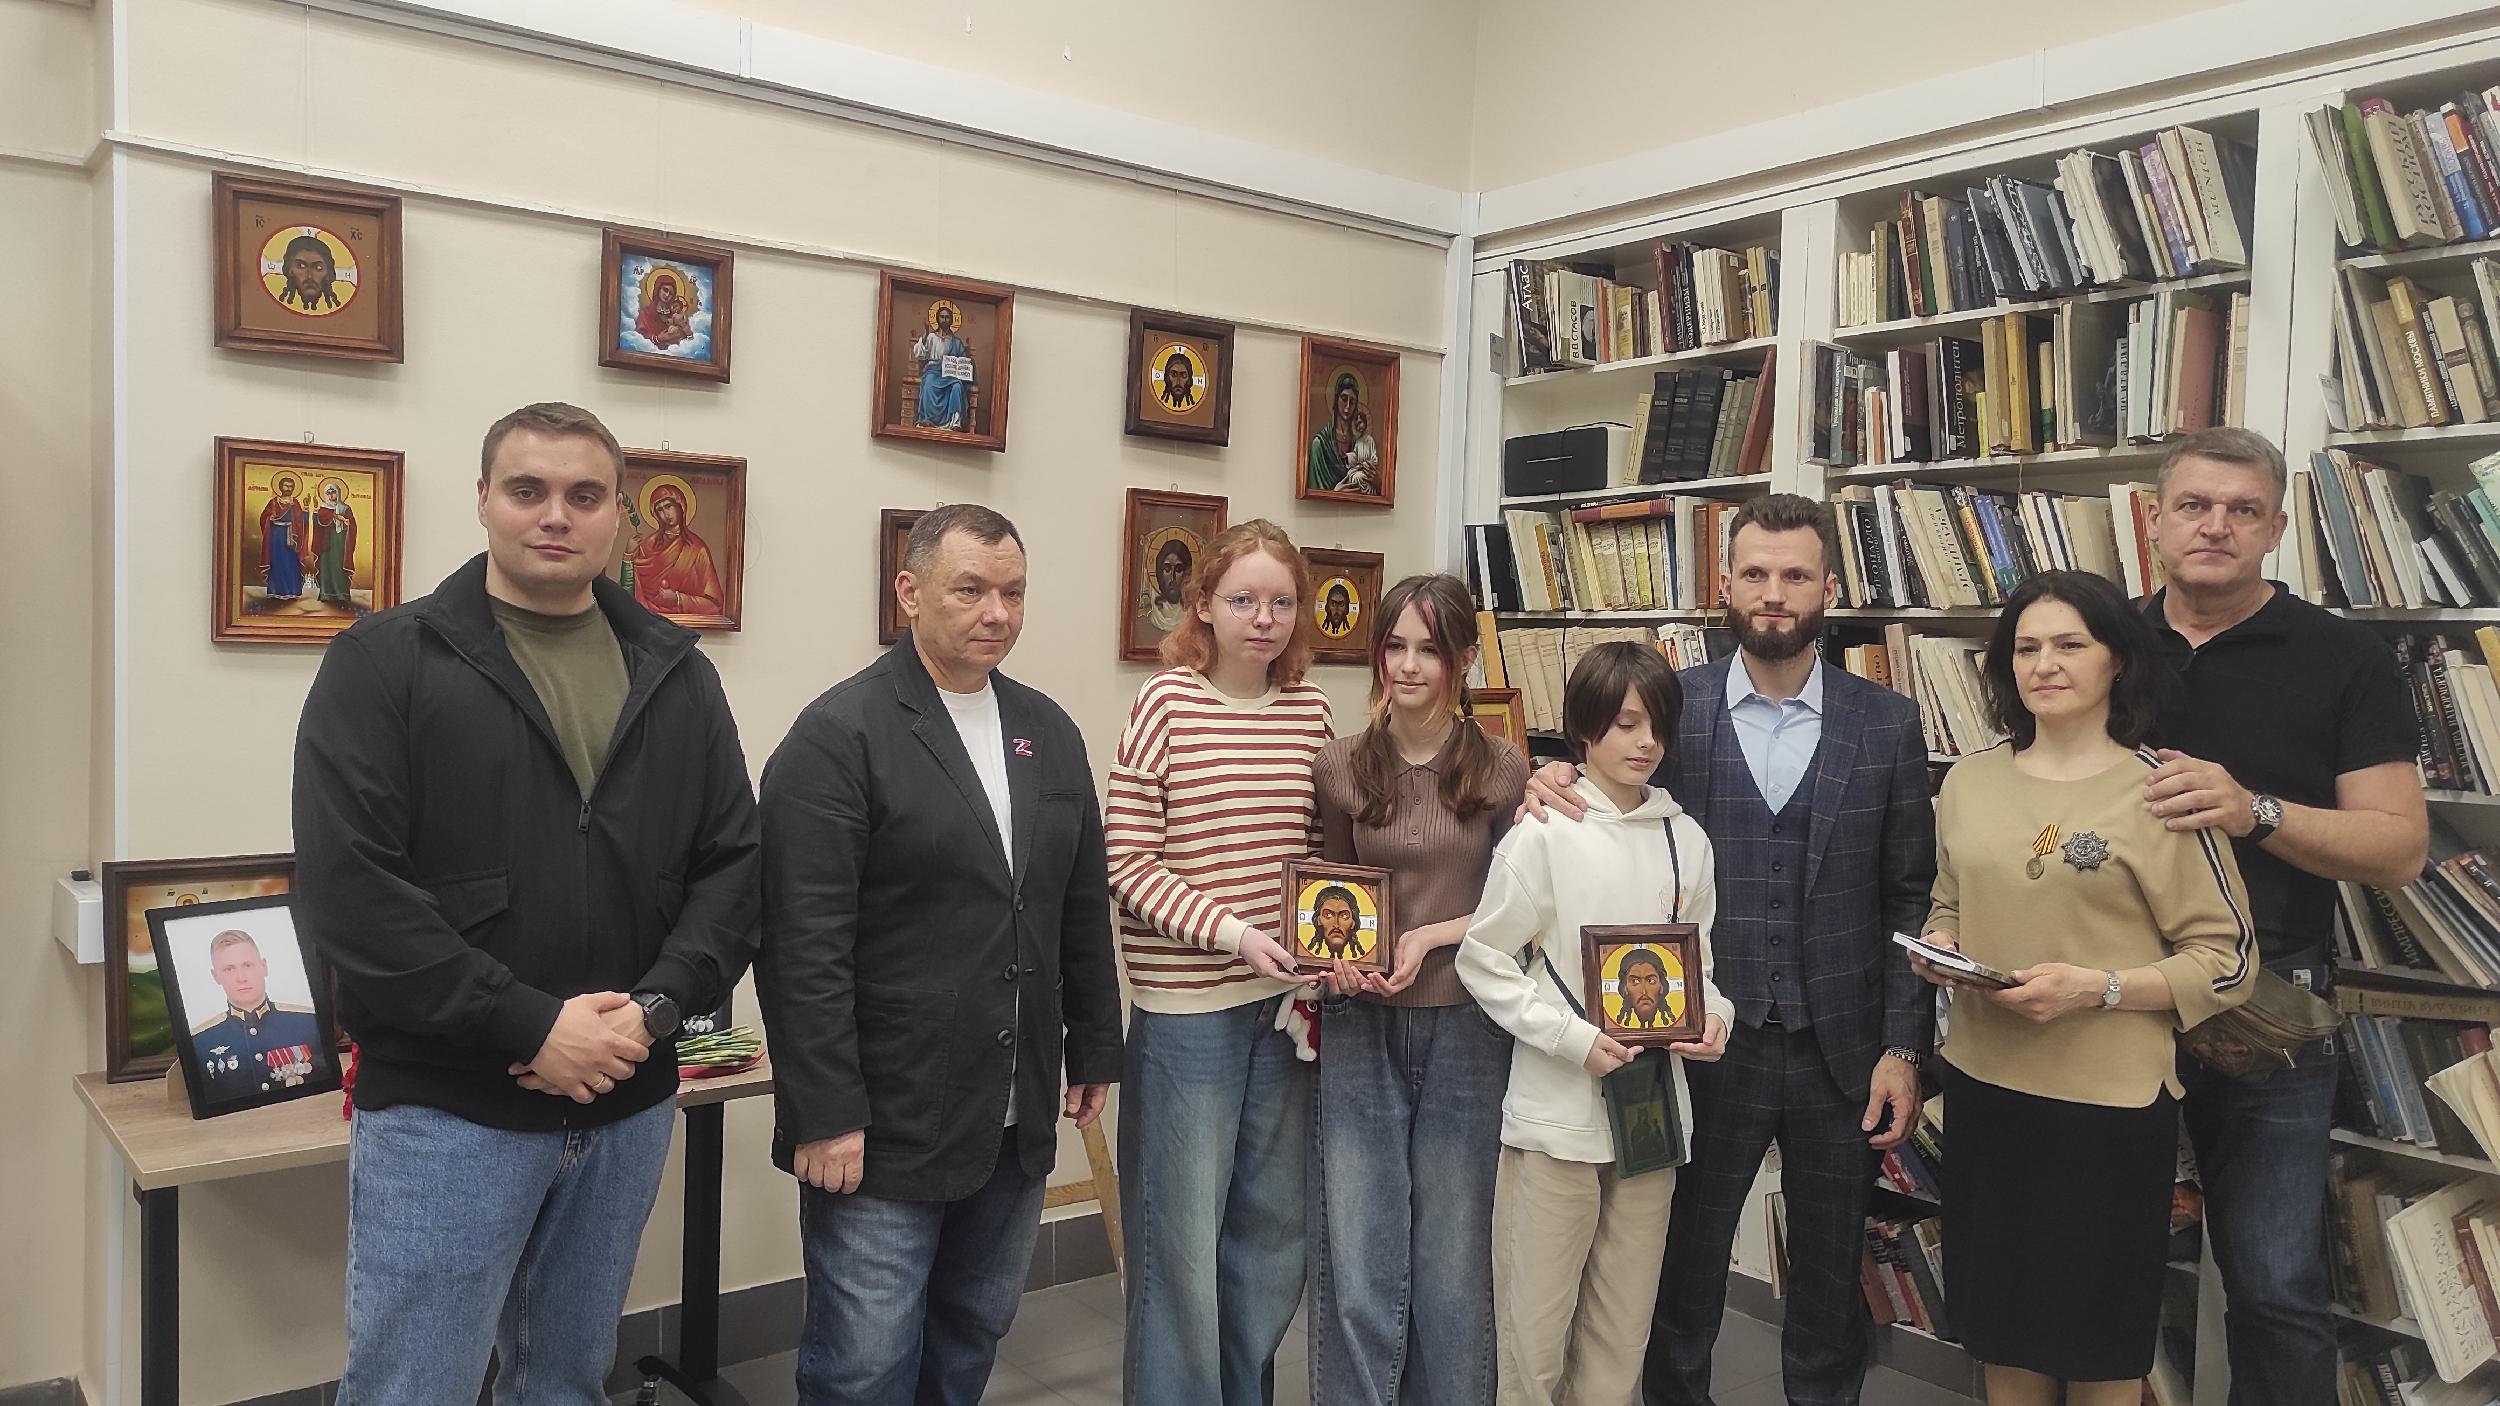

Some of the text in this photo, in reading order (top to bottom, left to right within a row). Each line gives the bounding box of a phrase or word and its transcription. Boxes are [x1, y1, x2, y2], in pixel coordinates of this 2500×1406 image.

[1519, 264, 1534, 312] Атлас
[1683, 287, 1695, 348] МОДЕРНИЗМ
[1952, 340, 1967, 449] Метрополитен
[2404, 330, 2440, 419] ПАМЯТНИКИ МОСКВЫ
[1864, 518, 1883, 594] ЛЕОНАРДО
